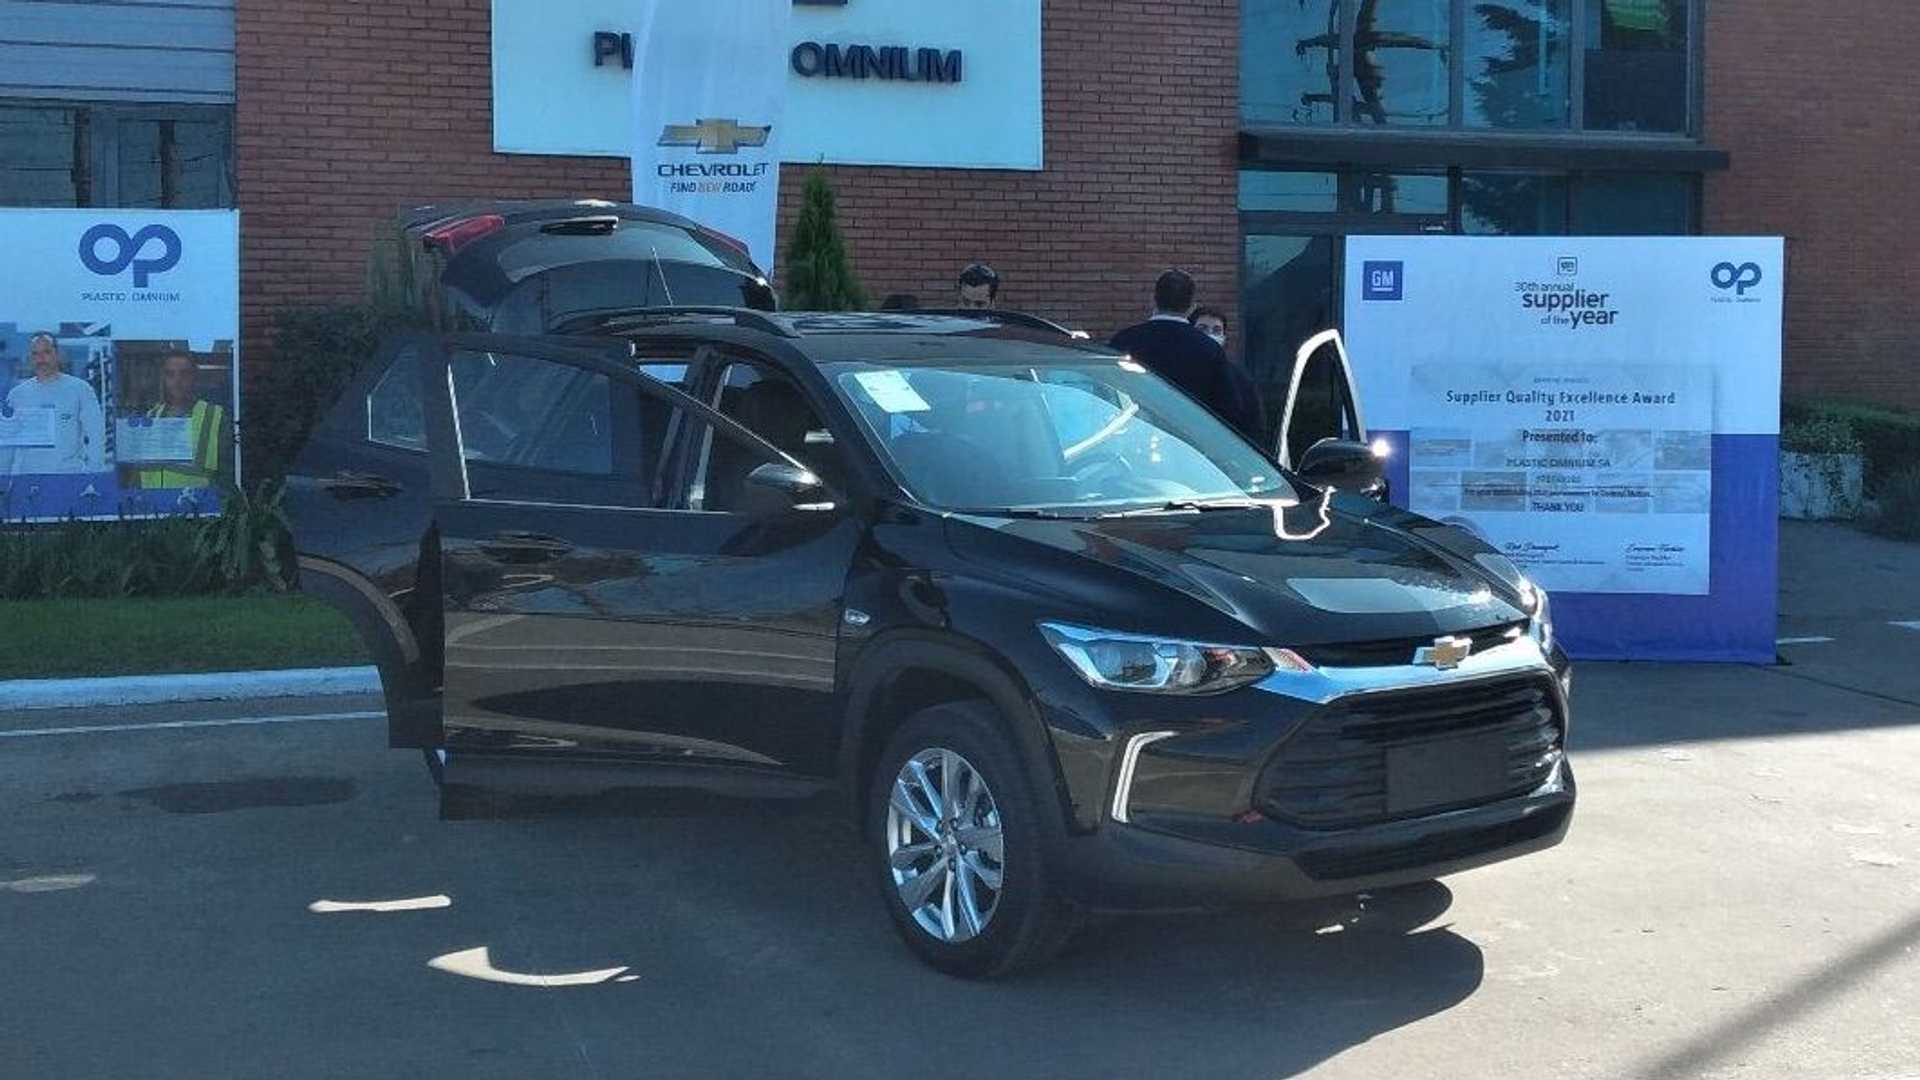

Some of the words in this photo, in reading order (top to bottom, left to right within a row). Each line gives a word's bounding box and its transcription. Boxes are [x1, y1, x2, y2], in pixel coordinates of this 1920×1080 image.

[792, 41, 963, 82] OMNIUM
[657, 162, 768, 177] CHEVROLET
[671, 182, 696, 193] FIND
[1372, 269, 1394, 287] GM
[1514, 281, 1539, 292] 30th
[1541, 281, 1574, 291] annual
[81, 292, 126, 302] PLASTIC
[131, 292, 180, 302] OMNIUM
[1522, 289, 1609, 312] supplier
[1541, 315, 1551, 325] of
[1553, 315, 1570, 325] the
[1569, 310, 1618, 330] year
[1446, 390, 1500, 406] Supplier
[1506, 390, 1554, 406] Quality
[1559, 391, 1628, 404] Excellence
[1631, 392, 1676, 405] Award
[1545, 410, 1575, 422] 2021
[1522, 430, 1579, 443] Presented
[1580, 431, 1599, 443] to:
[1506, 458, 1547, 468] PLASTIC
[1531, 501, 1563, 513] THANK
[1564, 502, 1585, 513] YOU
